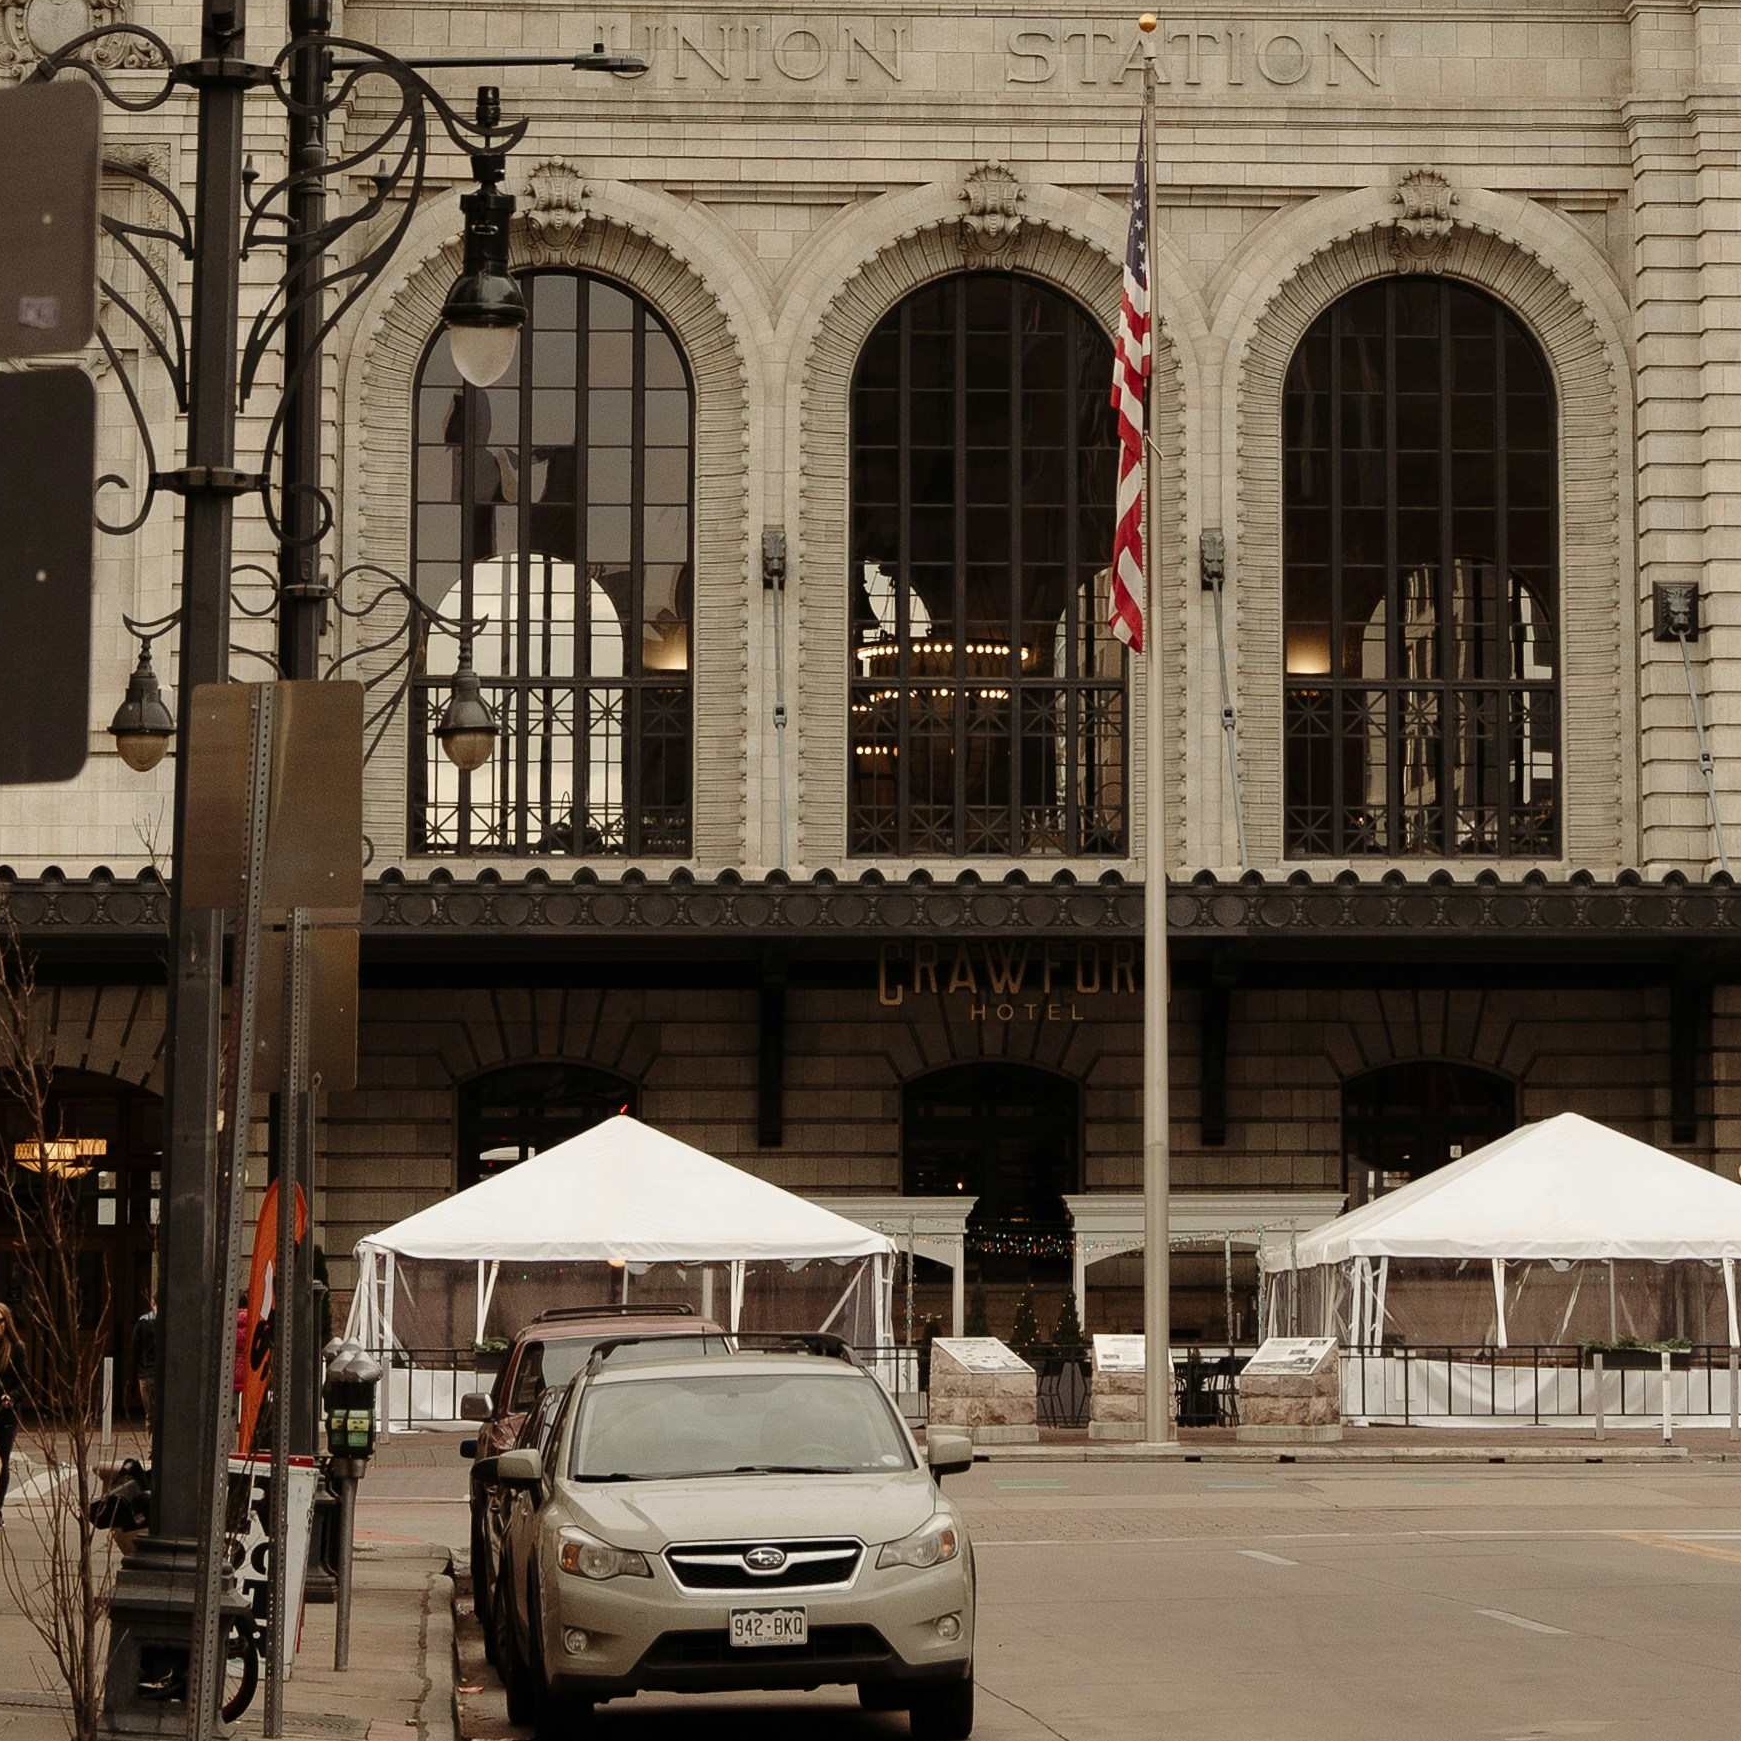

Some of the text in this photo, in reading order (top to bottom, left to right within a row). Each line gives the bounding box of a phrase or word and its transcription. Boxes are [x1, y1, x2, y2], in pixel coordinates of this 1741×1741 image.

[598, 23, 1384, 88] UNION STATION
[878, 940, 1172, 1007] CRAWFOR
[970, 1003, 1085, 1021] HOTEL
